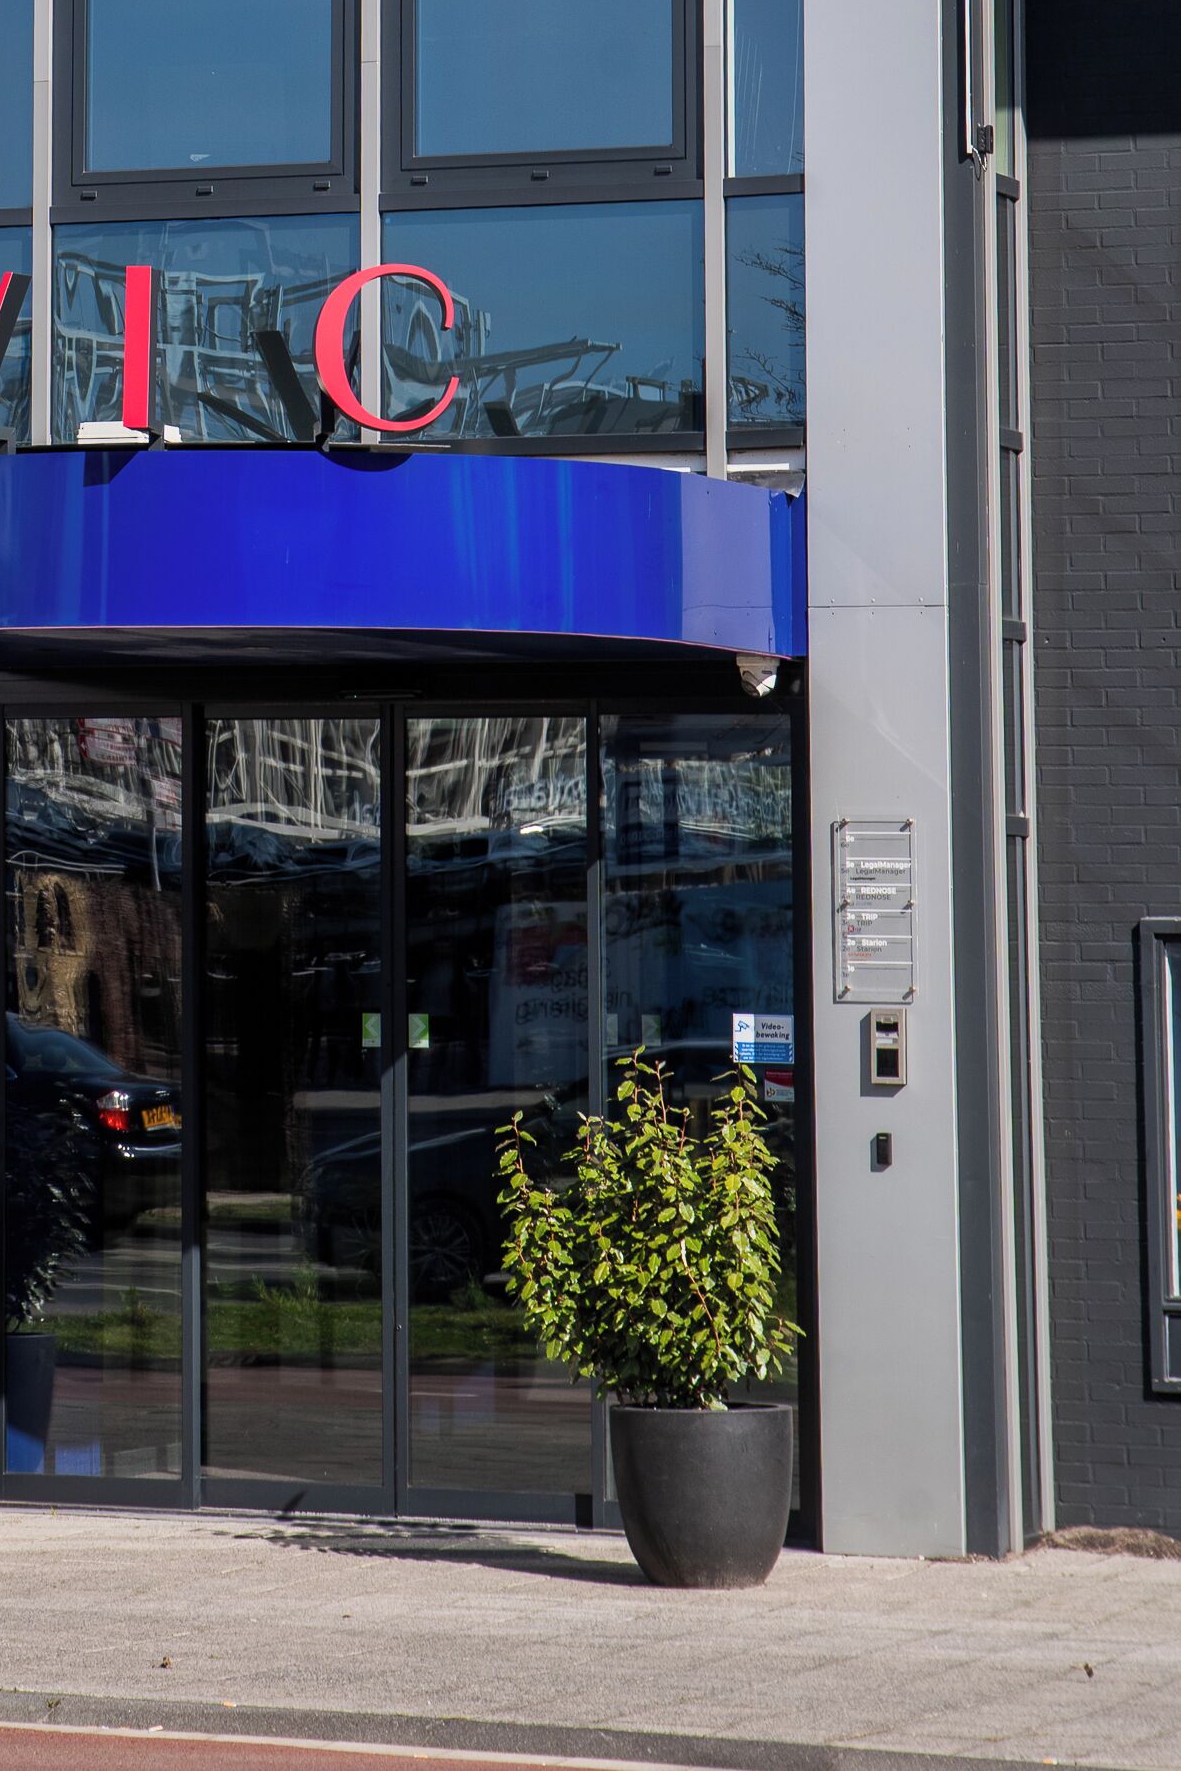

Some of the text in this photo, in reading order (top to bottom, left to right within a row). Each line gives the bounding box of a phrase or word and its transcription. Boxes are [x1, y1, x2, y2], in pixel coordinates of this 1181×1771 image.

[860, 861, 911, 869] LegalManager
[860, 887, 897, 895] REDNOSE
[761, 1022, 784, 1030] Video-
[755, 1031, 790, 1040] bewaking
